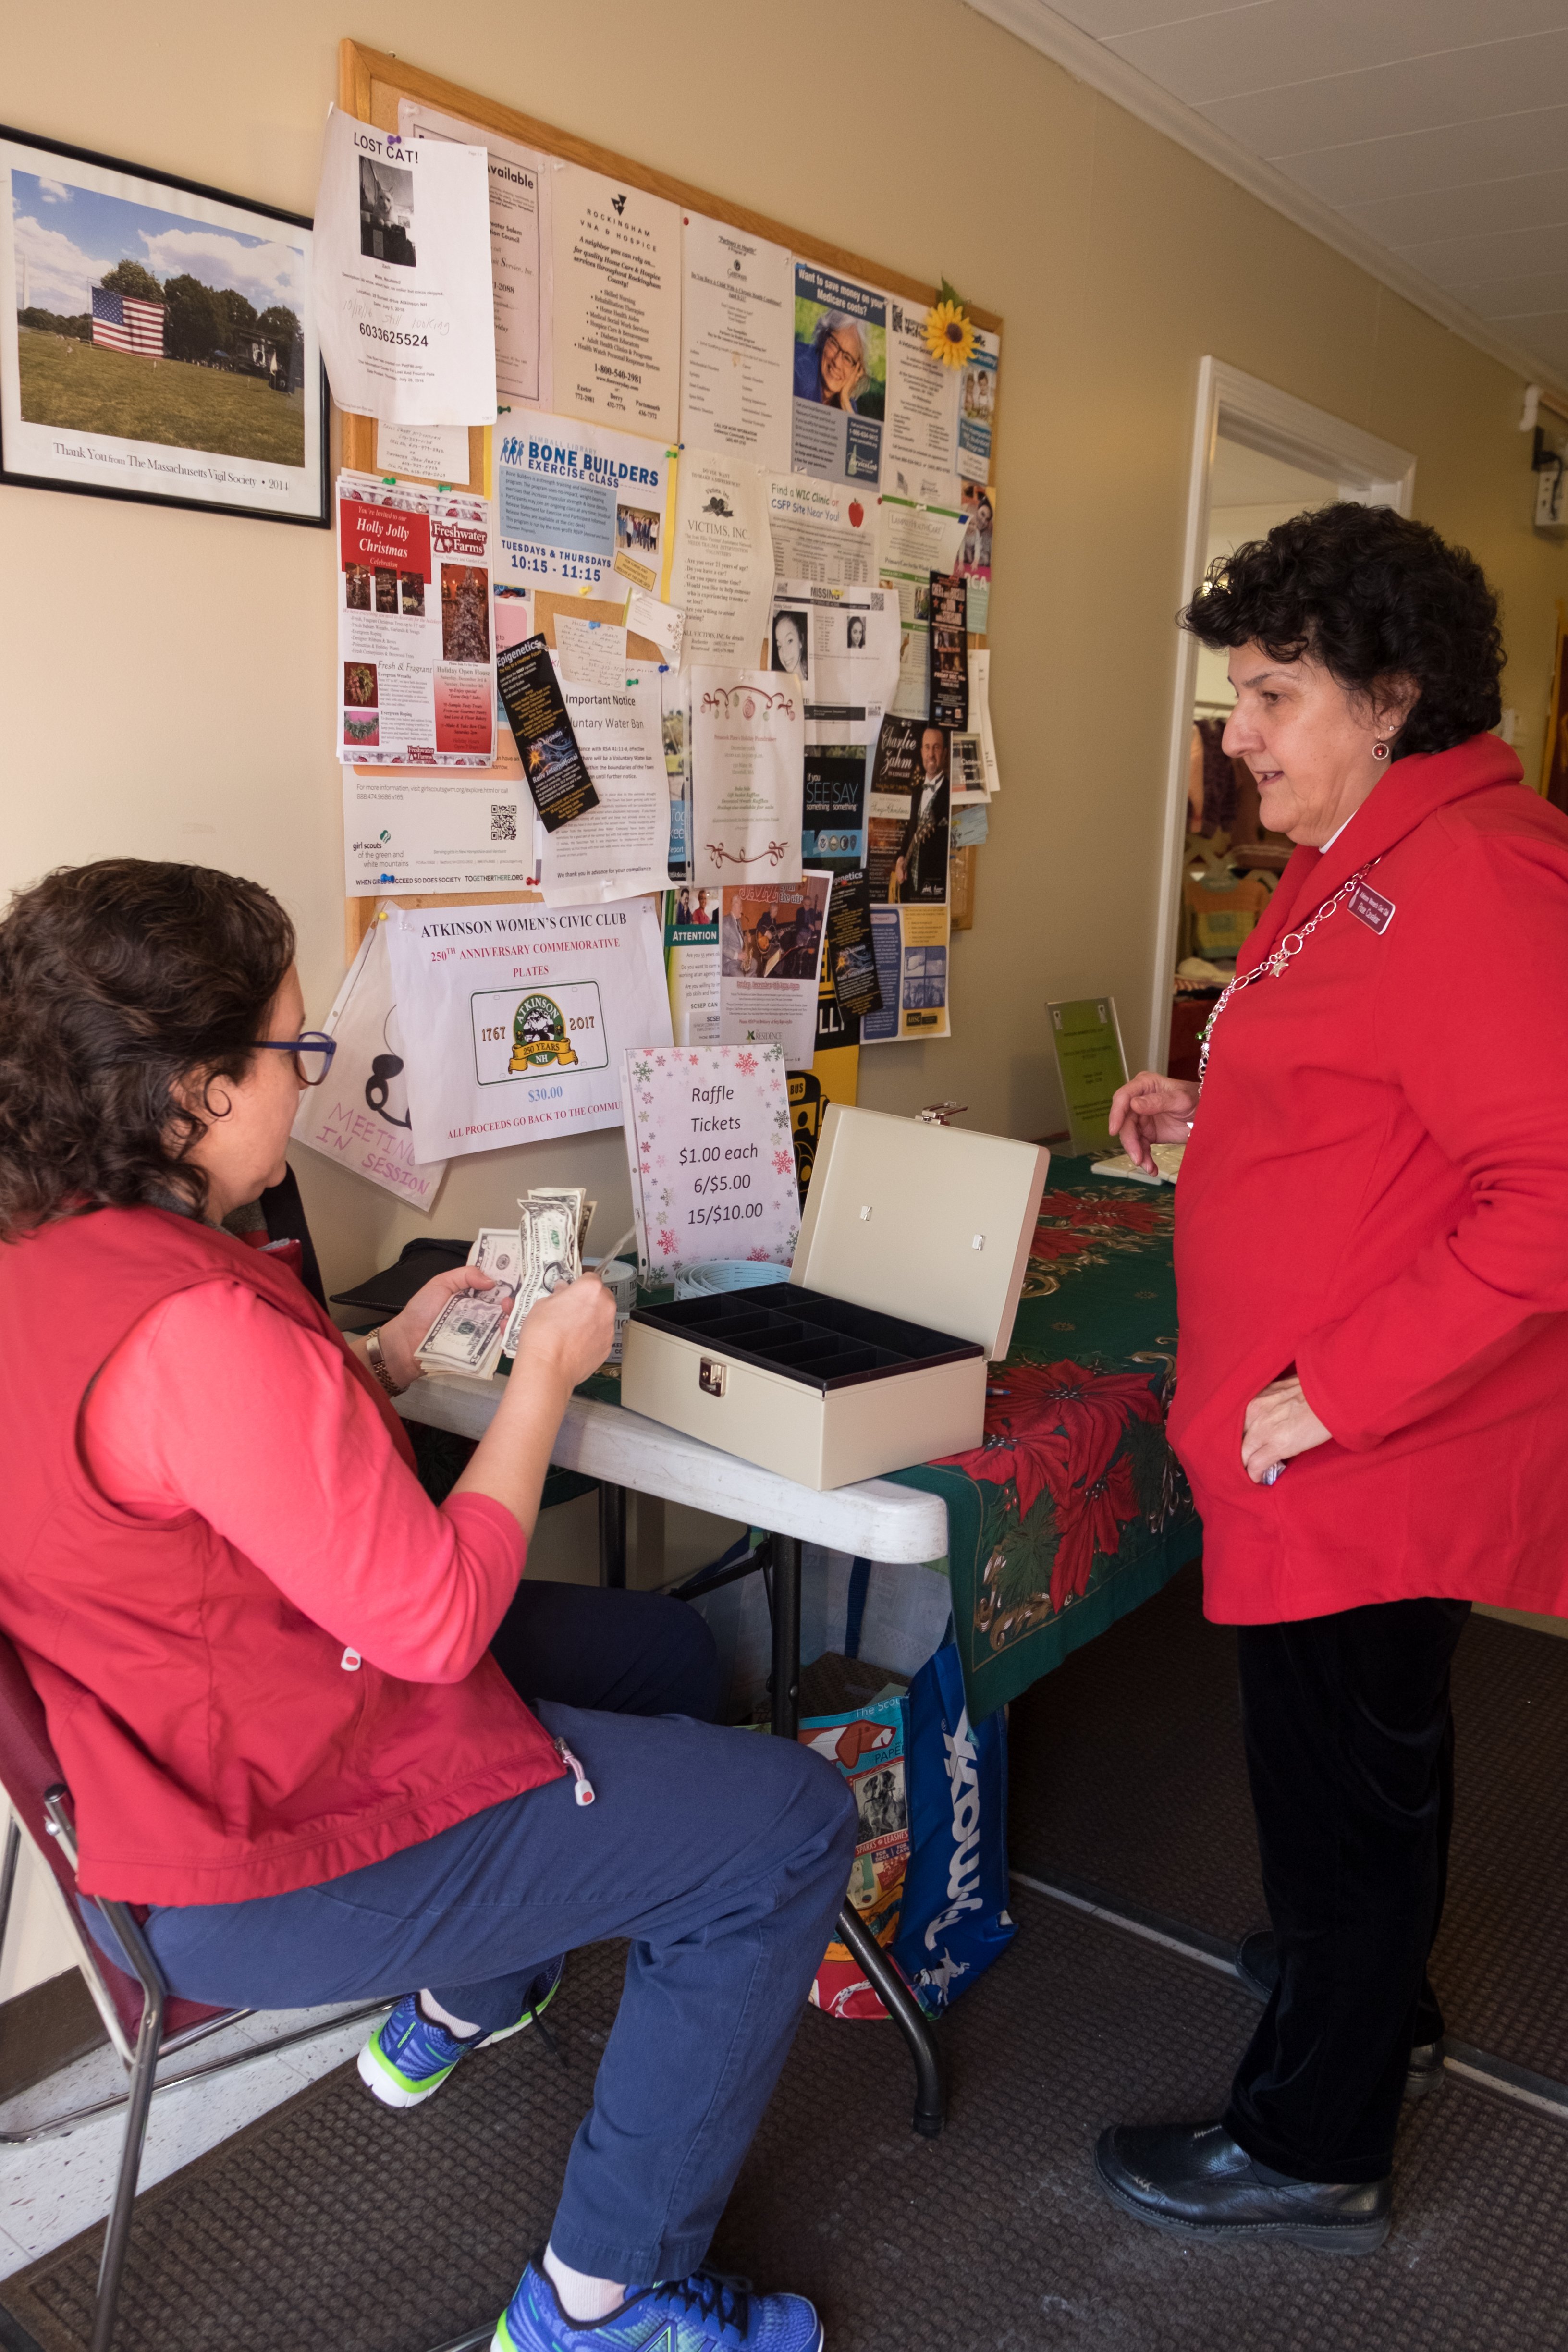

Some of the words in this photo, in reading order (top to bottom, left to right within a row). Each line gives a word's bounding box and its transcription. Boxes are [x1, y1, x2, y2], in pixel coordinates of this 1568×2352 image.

[354, 132, 382, 154] LOST
[386, 146, 418, 163] CAT!
[587, 209, 650, 237] ROCKINGHAM
[580, 219, 599, 231] VNA
[617, 233, 657, 252] HOSPICE
[799, 269, 815, 283] Want
[817, 274, 823, 286] to
[824, 280, 839, 292] save
[841, 286, 861, 303] money
[861, 294, 870, 305] on
[870, 297, 884, 309] your
[817, 288, 846, 308] Medicare
[847, 302, 867, 317] costs?
[359, 322, 429, 347] 6033625524
[594, 364, 642, 384] 1-800-540-2981
[53, 442, 86, 459] Thank
[87, 449, 107, 462] You
[108, 455, 125, 465] from
[127, 455, 146, 468] The
[147, 458, 207, 478] Massachusetts
[208, 469, 226, 482] Vigil
[227, 472, 257, 488] Society
[269, 478, 288, 491] 2014
[529, 442, 578, 467] BONE
[584, 454, 659, 487] BUILDERS
[529, 459, 585, 479] EXERCISE
[589, 473, 619, 488] CLASS
[772, 483, 788, 496] Find
[796, 488, 810, 500] WIC
[812, 492, 830, 505] Clinic
[772, 499, 791, 511] CSFP
[793, 502, 805, 514] Site
[807, 507, 823, 518] Near
[825, 511, 839, 521] You!
[356, 518, 384, 537] Holly
[386, 524, 409, 541] Jolly
[433, 523, 486, 542] Freshwater
[688, 520, 730, 538] VICTIMS,
[733, 527, 750, 540] INC.
[359, 538, 408, 558] Christmas
[453, 539, 483, 554] Farms
[502, 540, 546, 556] TUESDAYS
[550, 550, 555, 558] &
[559, 551, 611, 568] THURSDAYS
[370, 558, 398, 568] Celebration
[512, 554, 548, 573] 10:15
[562, 564, 600, 582] 11:15
[810, 587, 840, 600] MISSING
[497, 640, 540, 667] Epigenetics
[378, 661, 396, 670] Fresh
[398, 662, 404, 670] &
[406, 663, 432, 673] Fragrant
[437, 666, 457, 675] Holiday
[459, 667, 473, 676] Open
[475, 667, 490, 676] House
[566, 694, 611, 706] Important
[613, 696, 636, 706] Notice
[571, 717, 602, 730] luntary
[606, 718, 629, 728] Water
[631, 719, 644, 728] Ban
[882, 724, 917, 750] Charlie
[408, 745, 434, 754] Freshwater
[807, 773, 811, 781] if
[812, 774, 821, 782] you
[807, 783, 830, 803] SEE
[833, 783, 858, 803] SAY
[353, 842, 363, 850] girl
[375, 852, 391, 860] green
[421, 919, 493, 938] ATKINSON
[496, 915, 557, 932] WOMEN'S
[559, 915, 593, 929] CIVIC
[596, 912, 626, 926] CLUB
[431, 947, 456, 962] 250TH
[459, 944, 530, 960] ANNIVERSARY
[533, 938, 620, 954] COMMEMORATIVE
[513, 966, 549, 978] PLATES
[516, 997, 560, 1024] ATKINSON
[482, 1026, 506, 1041] 1767
[569, 1016, 595, 1030] 2017
[523, 1046, 534, 1055] 250
[536, 1054, 548, 1064] NH
[528, 1086, 563, 1103] $30.00
[692, 1086, 734, 1104] Raffle
[790, 1083, 803, 1095] BUS
[448, 1127, 464, 1139] ALL
[465, 1119, 512, 1136] PROCEEDS
[513, 1116, 527, 1127] GO
[528, 1112, 552, 1125] BACK
[554, 1110, 567, 1119] TO
[568, 1107, 586, 1117] THE
[691, 1116, 741, 1132] Tickets
[316, 1126, 353, 1151] IN
[328, 1102, 416, 1166] MEETING
[679, 1147, 720, 1166] $1.00
[725, 1144, 759, 1160] each
[362, 1153, 430, 1195] SESSION
[694, 1174, 751, 1195] 6/$5.00
[688, 1203, 763, 1225] 15/$10.00
[856, 1707, 874, 1717] The
[857, 1840, 876, 1854] SPARKS
[884, 1831, 908, 1844] LEASHES
